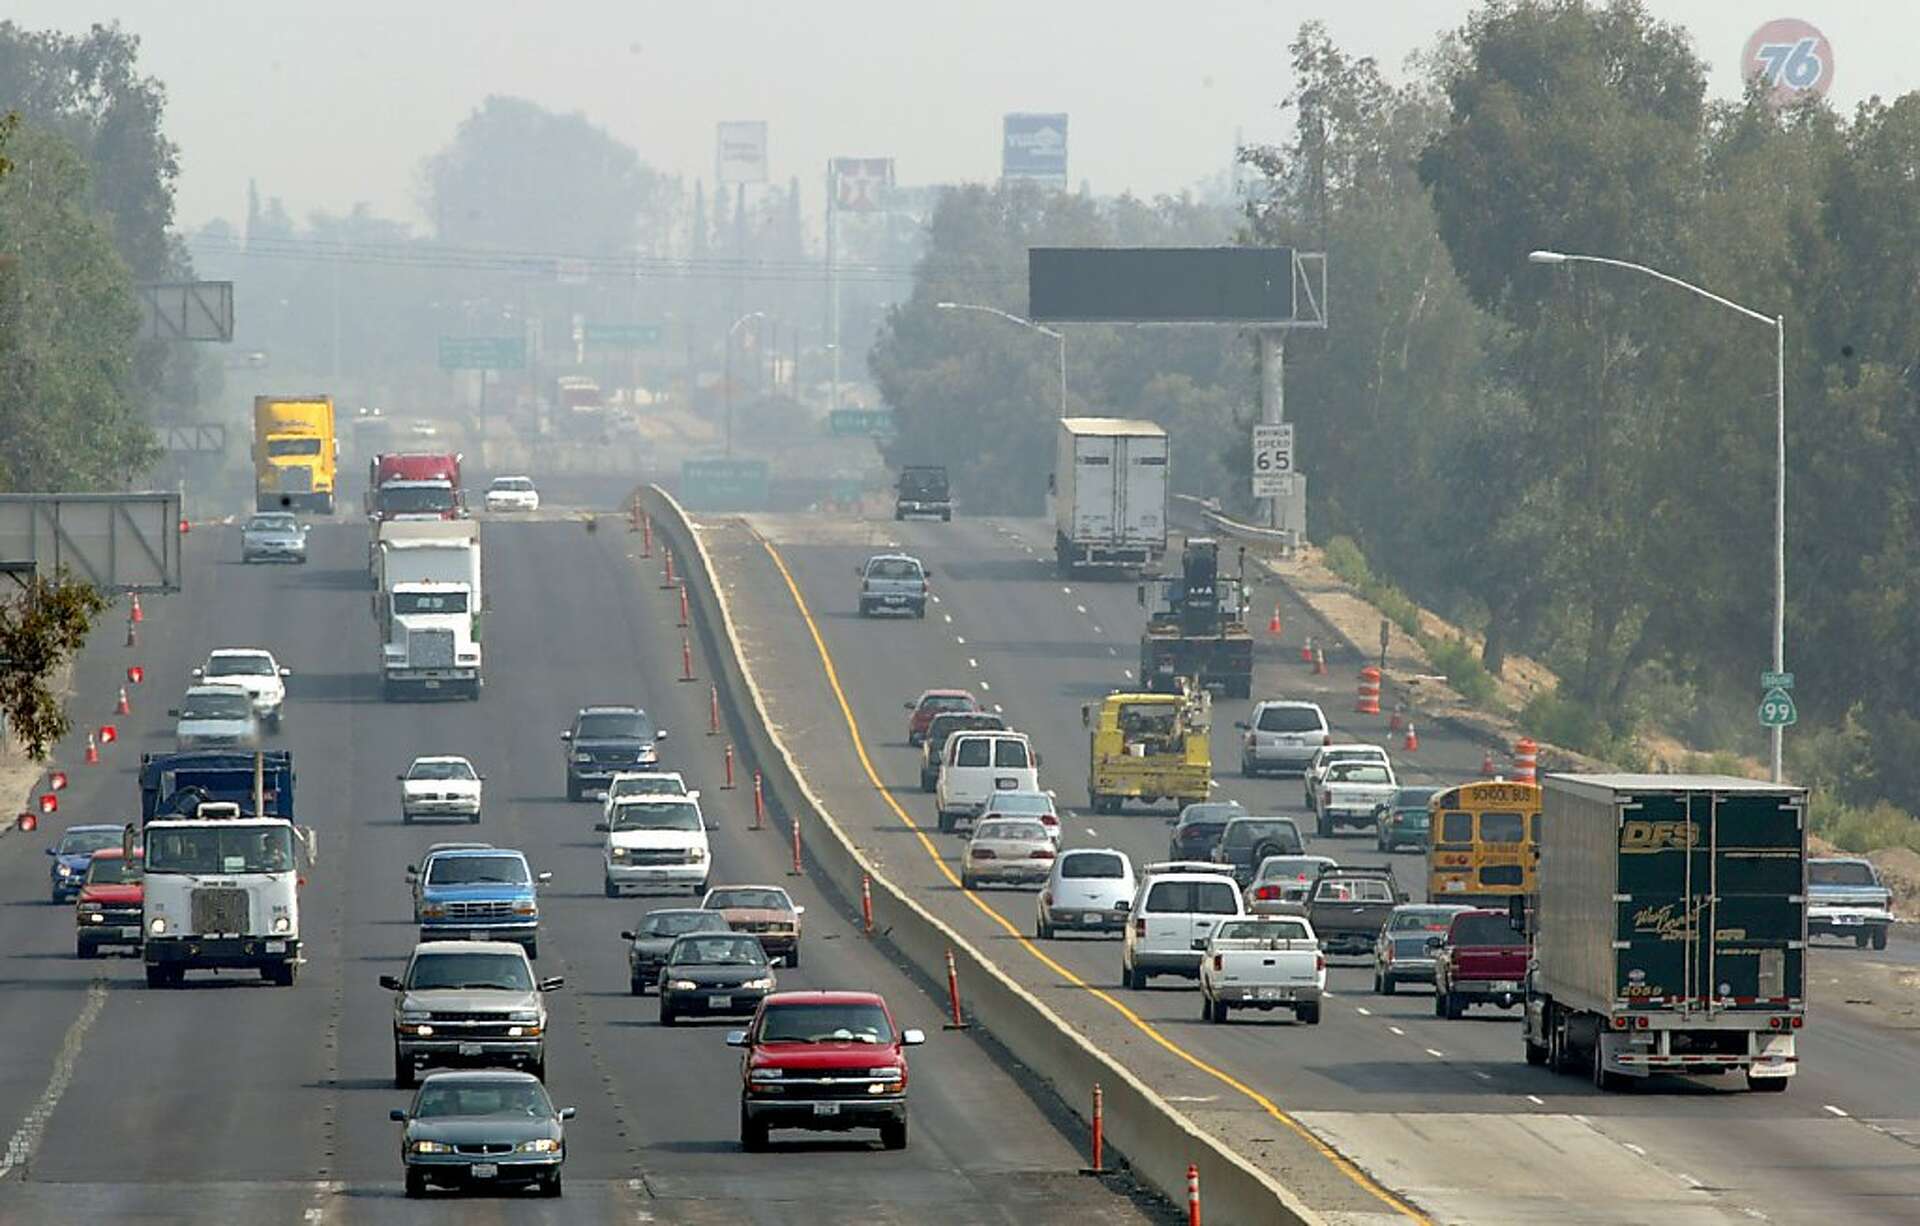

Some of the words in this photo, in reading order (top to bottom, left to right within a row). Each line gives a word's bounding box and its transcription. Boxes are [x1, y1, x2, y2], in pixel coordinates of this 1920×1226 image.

[1755, 38, 1821, 90] 76
[1257, 451, 1289, 470] 65
[1765, 703, 1789, 721] 99
[1472, 788, 1507, 801] SCHOOL
[1513, 788, 1531, 801] BUS
[1622, 821, 1699, 848] DFS
